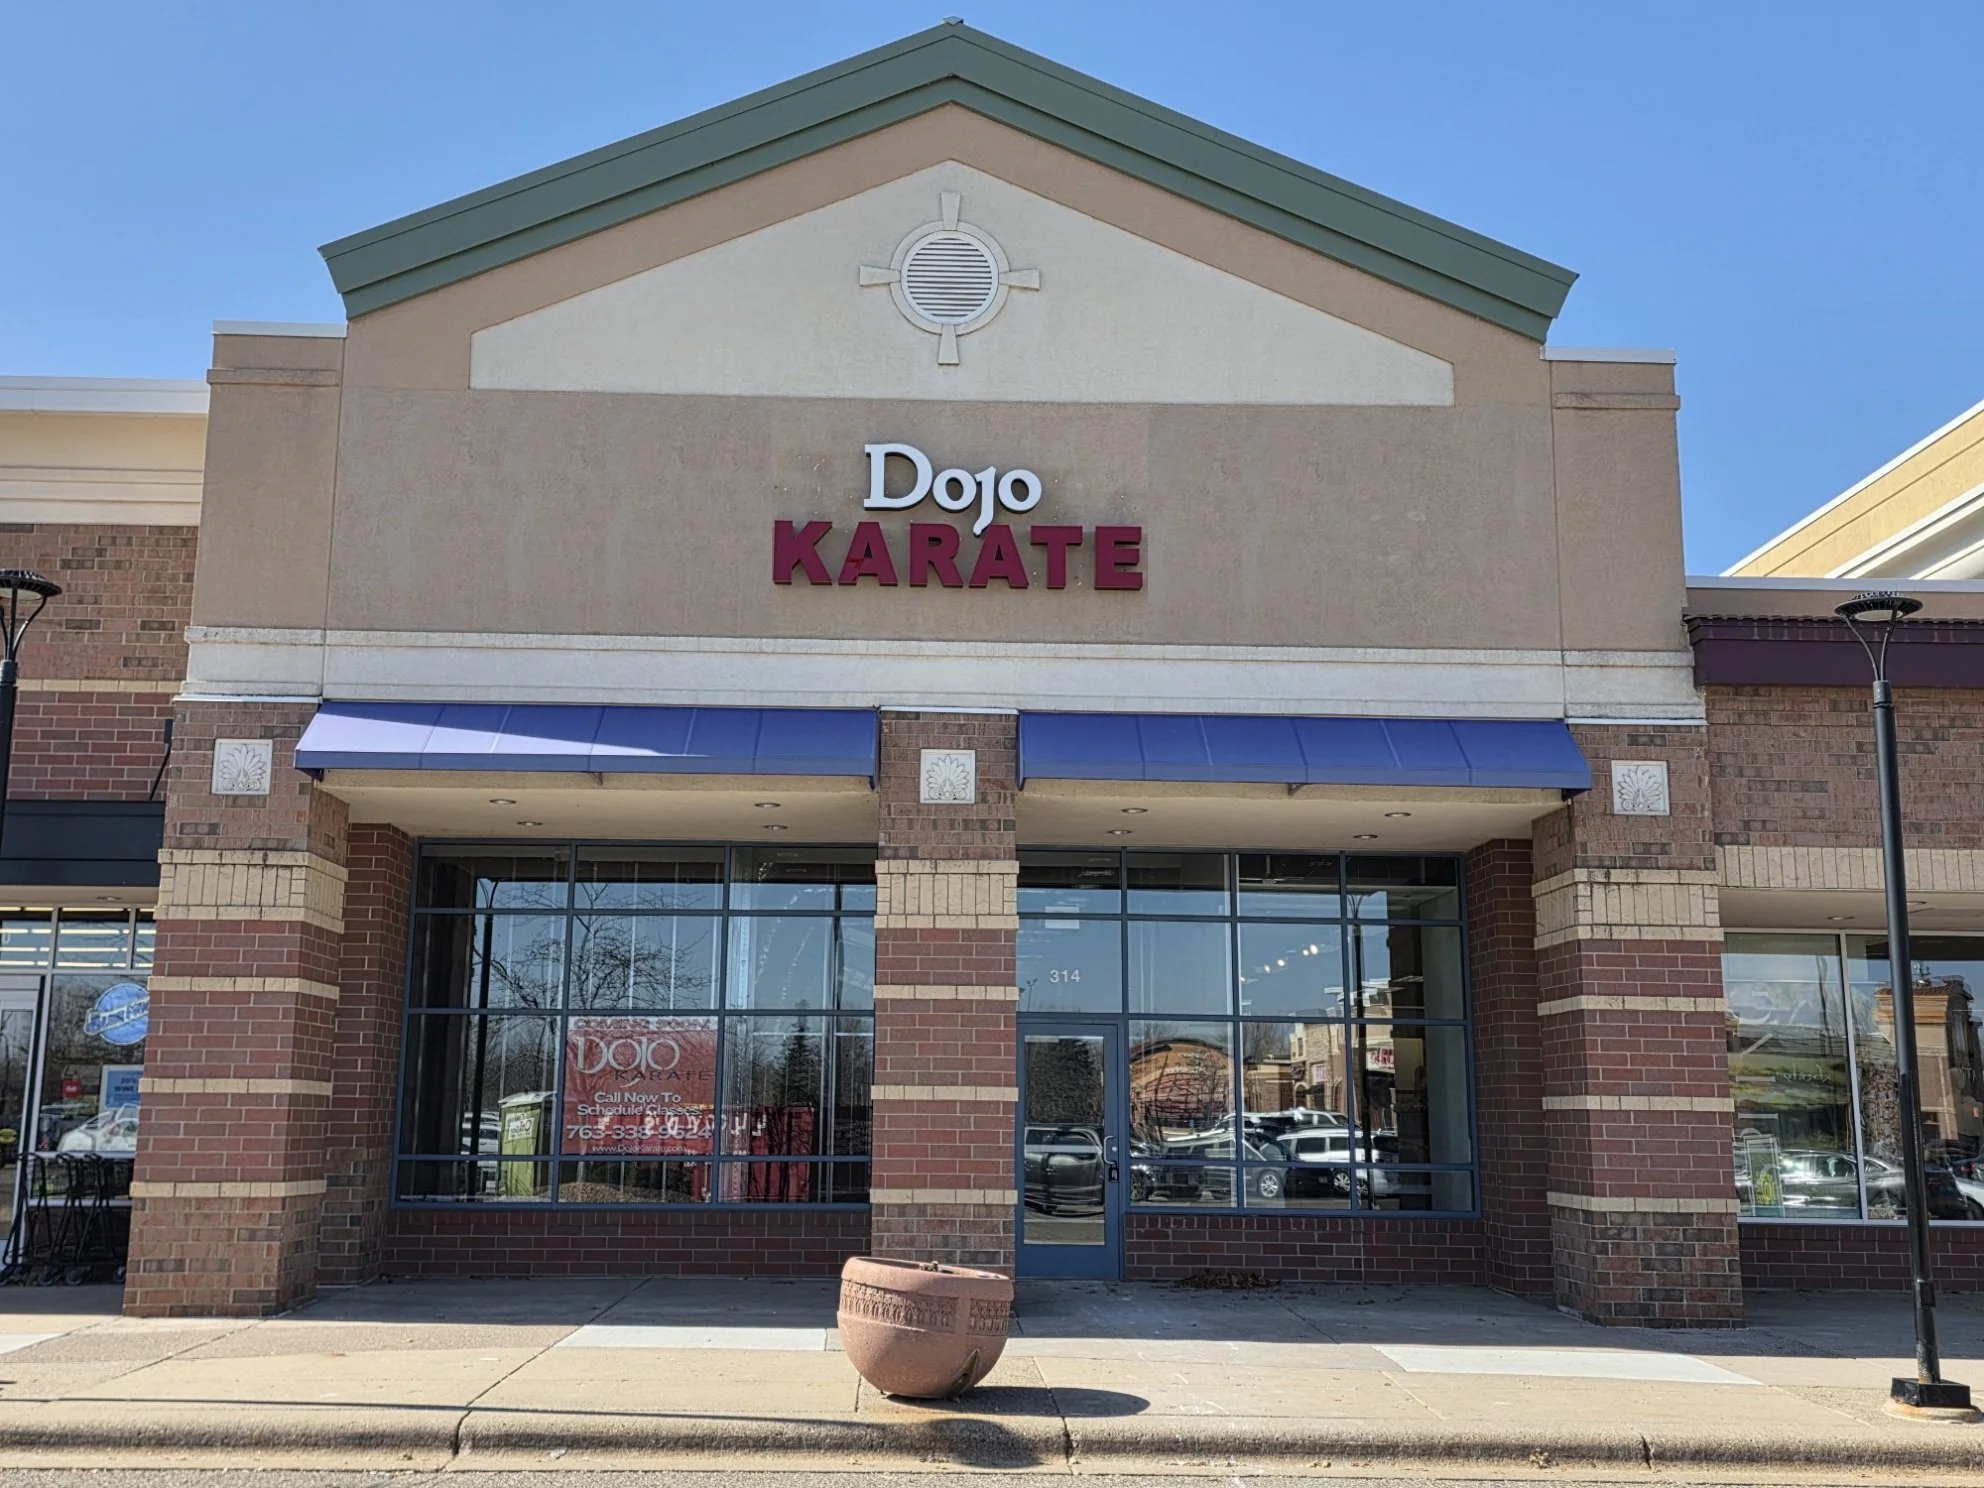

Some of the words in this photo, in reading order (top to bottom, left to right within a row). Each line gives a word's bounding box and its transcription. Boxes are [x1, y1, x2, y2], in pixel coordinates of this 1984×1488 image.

[863, 442, 1043, 537] Dojo
[772, 520, 1144, 590] KARATE
[1049, 969, 1081, 983] 314
[614, 1070, 710, 1081] KARATE
[594, 1091, 620, 1103] Call
[624, 1091, 658, 1103] Now
[661, 1092, 681, 1103] To
[577, 1104, 643, 1116] Schedule
